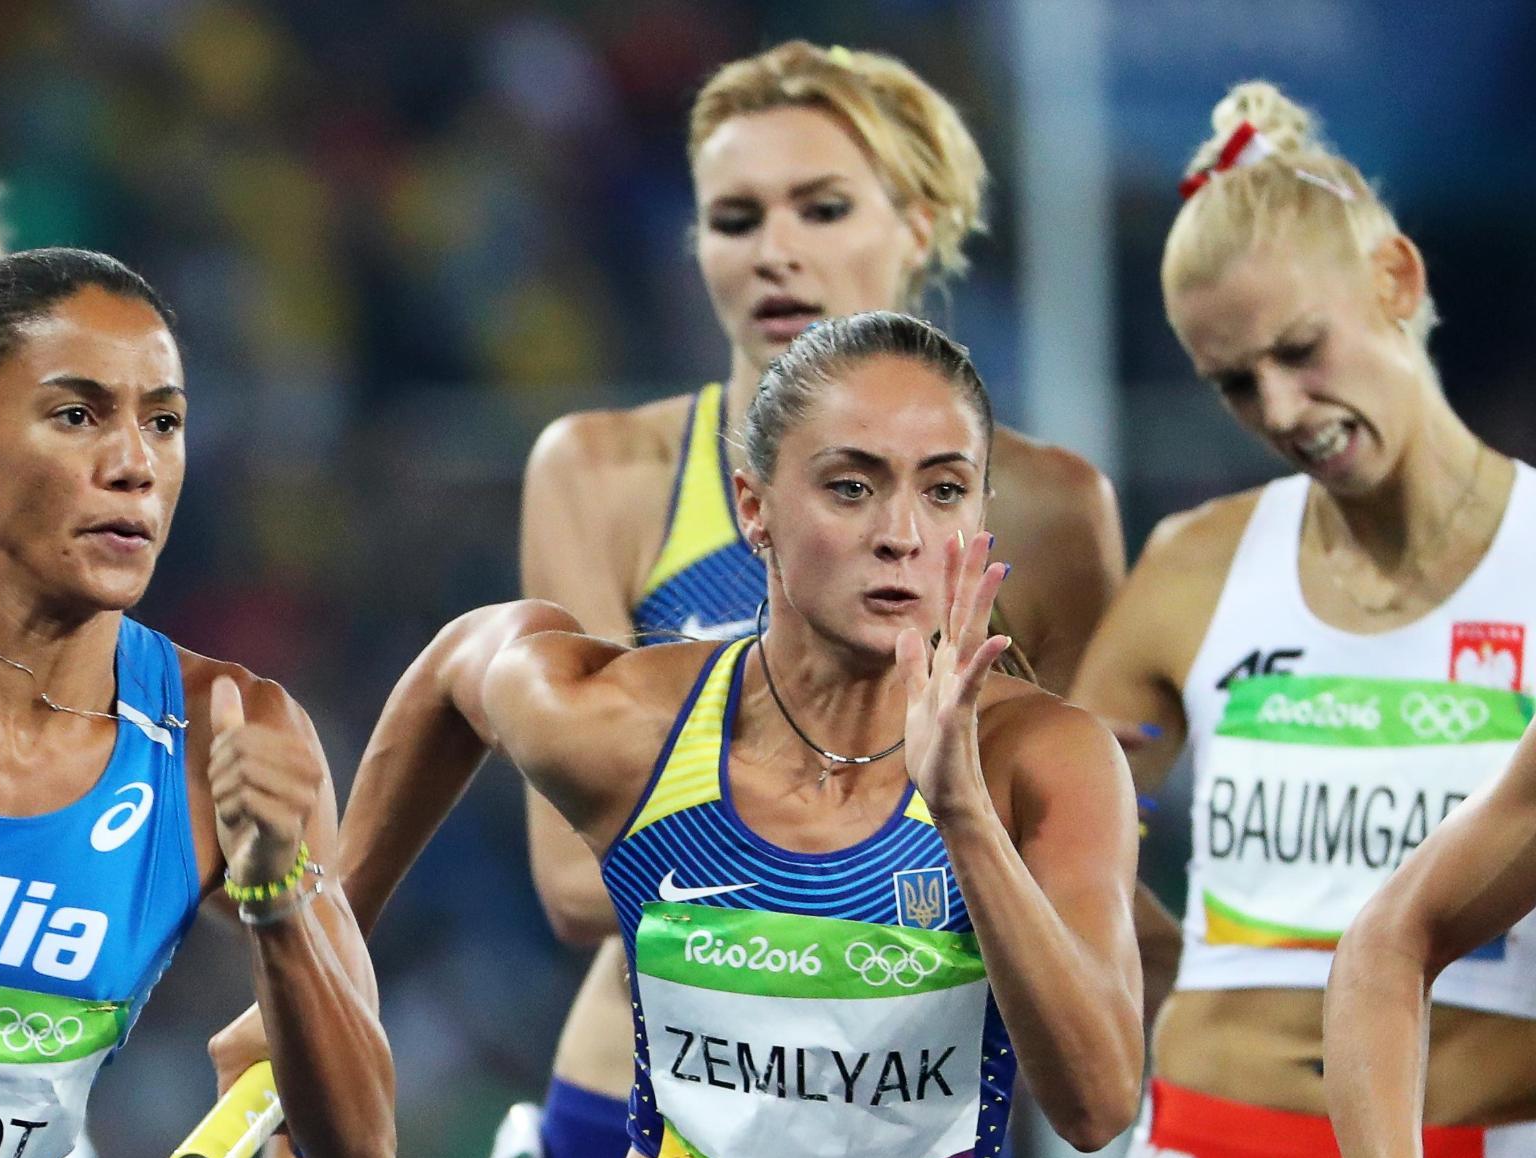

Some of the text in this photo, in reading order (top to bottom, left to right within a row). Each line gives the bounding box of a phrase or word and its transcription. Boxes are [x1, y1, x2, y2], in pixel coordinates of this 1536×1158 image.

[1259, 690, 1382, 731] Rio2016
[684, 929, 823, 977] Rio2016
[664, 1025, 957, 1106] ZEMLYAK
